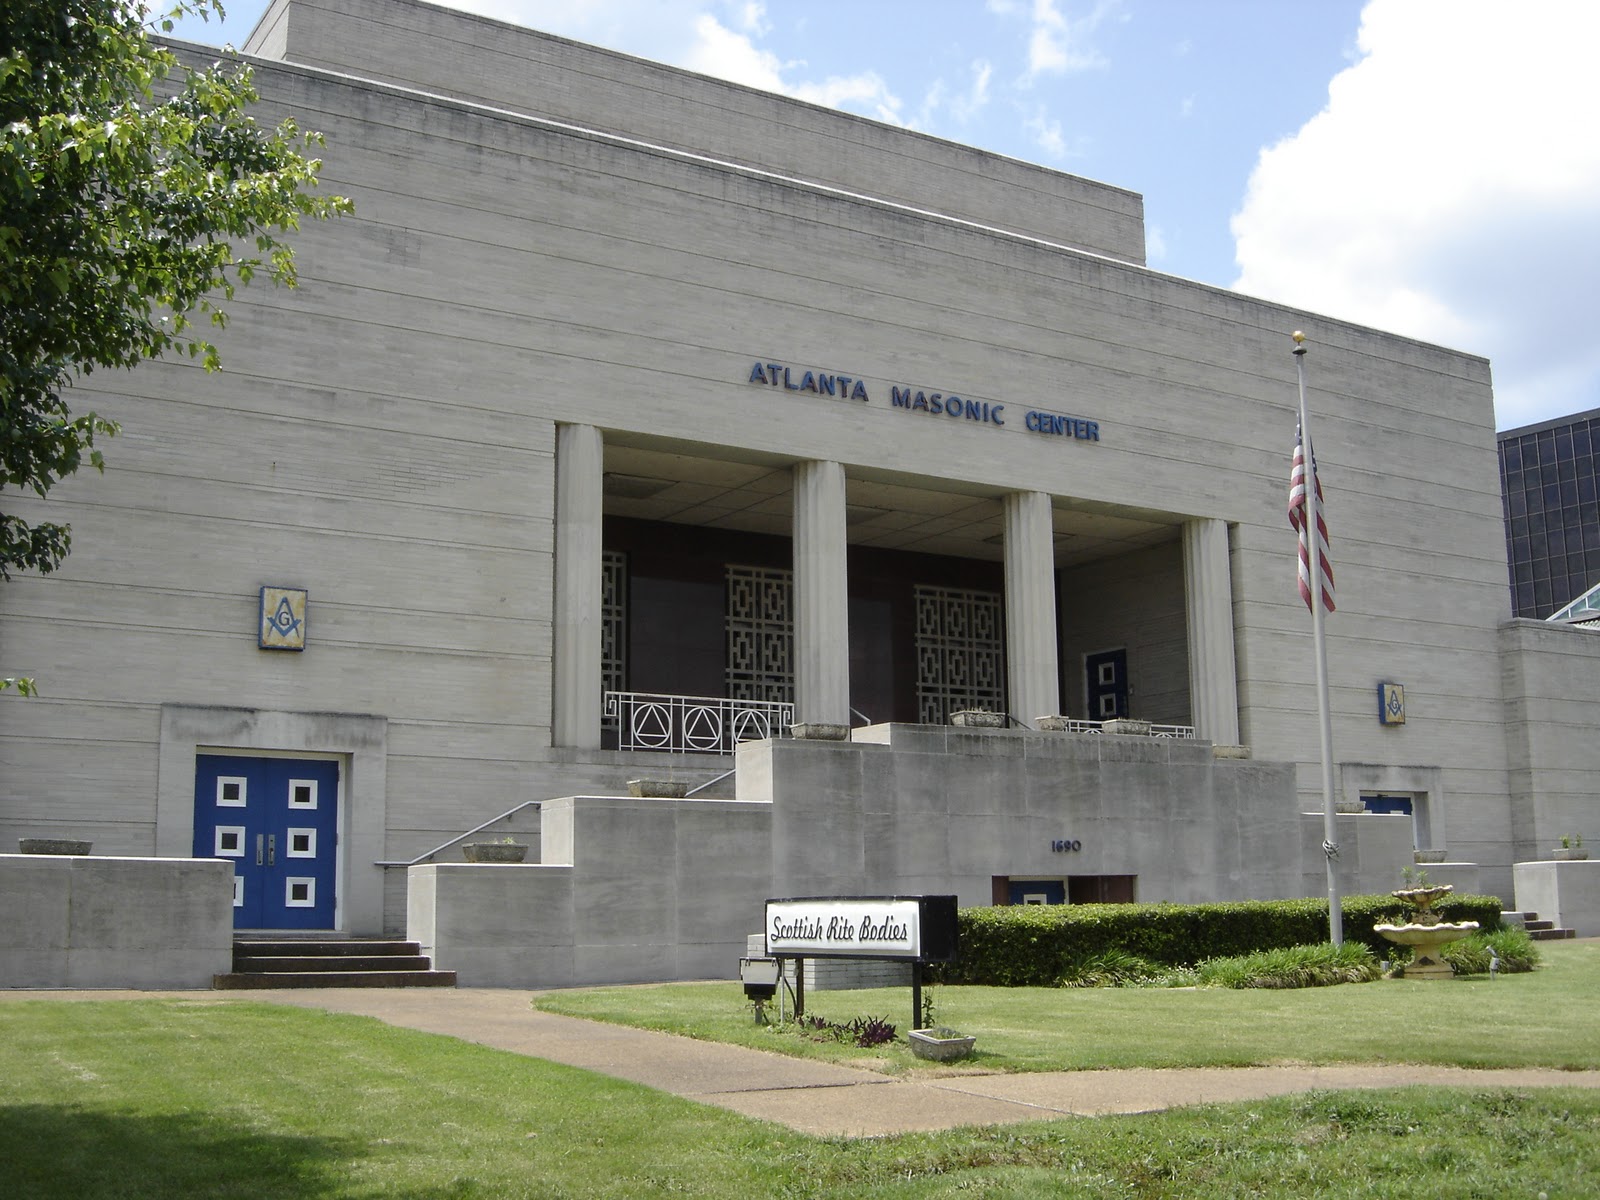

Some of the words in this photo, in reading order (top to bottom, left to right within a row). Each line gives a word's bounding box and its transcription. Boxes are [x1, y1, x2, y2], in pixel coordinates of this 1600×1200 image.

[750, 362, 869, 402] ATLANTA
[891, 386, 1005, 426] MASONIC
[1025, 410, 1100, 441] CENTER
[278, 611, 290, 626] G
[1391, 699, 1398, 710] G
[1051, 840, 1082, 853] 1690
[770, 915, 823, 942] Scottish
[826, 915, 855, 941] Rite
[859, 915, 908, 942] Bodies
